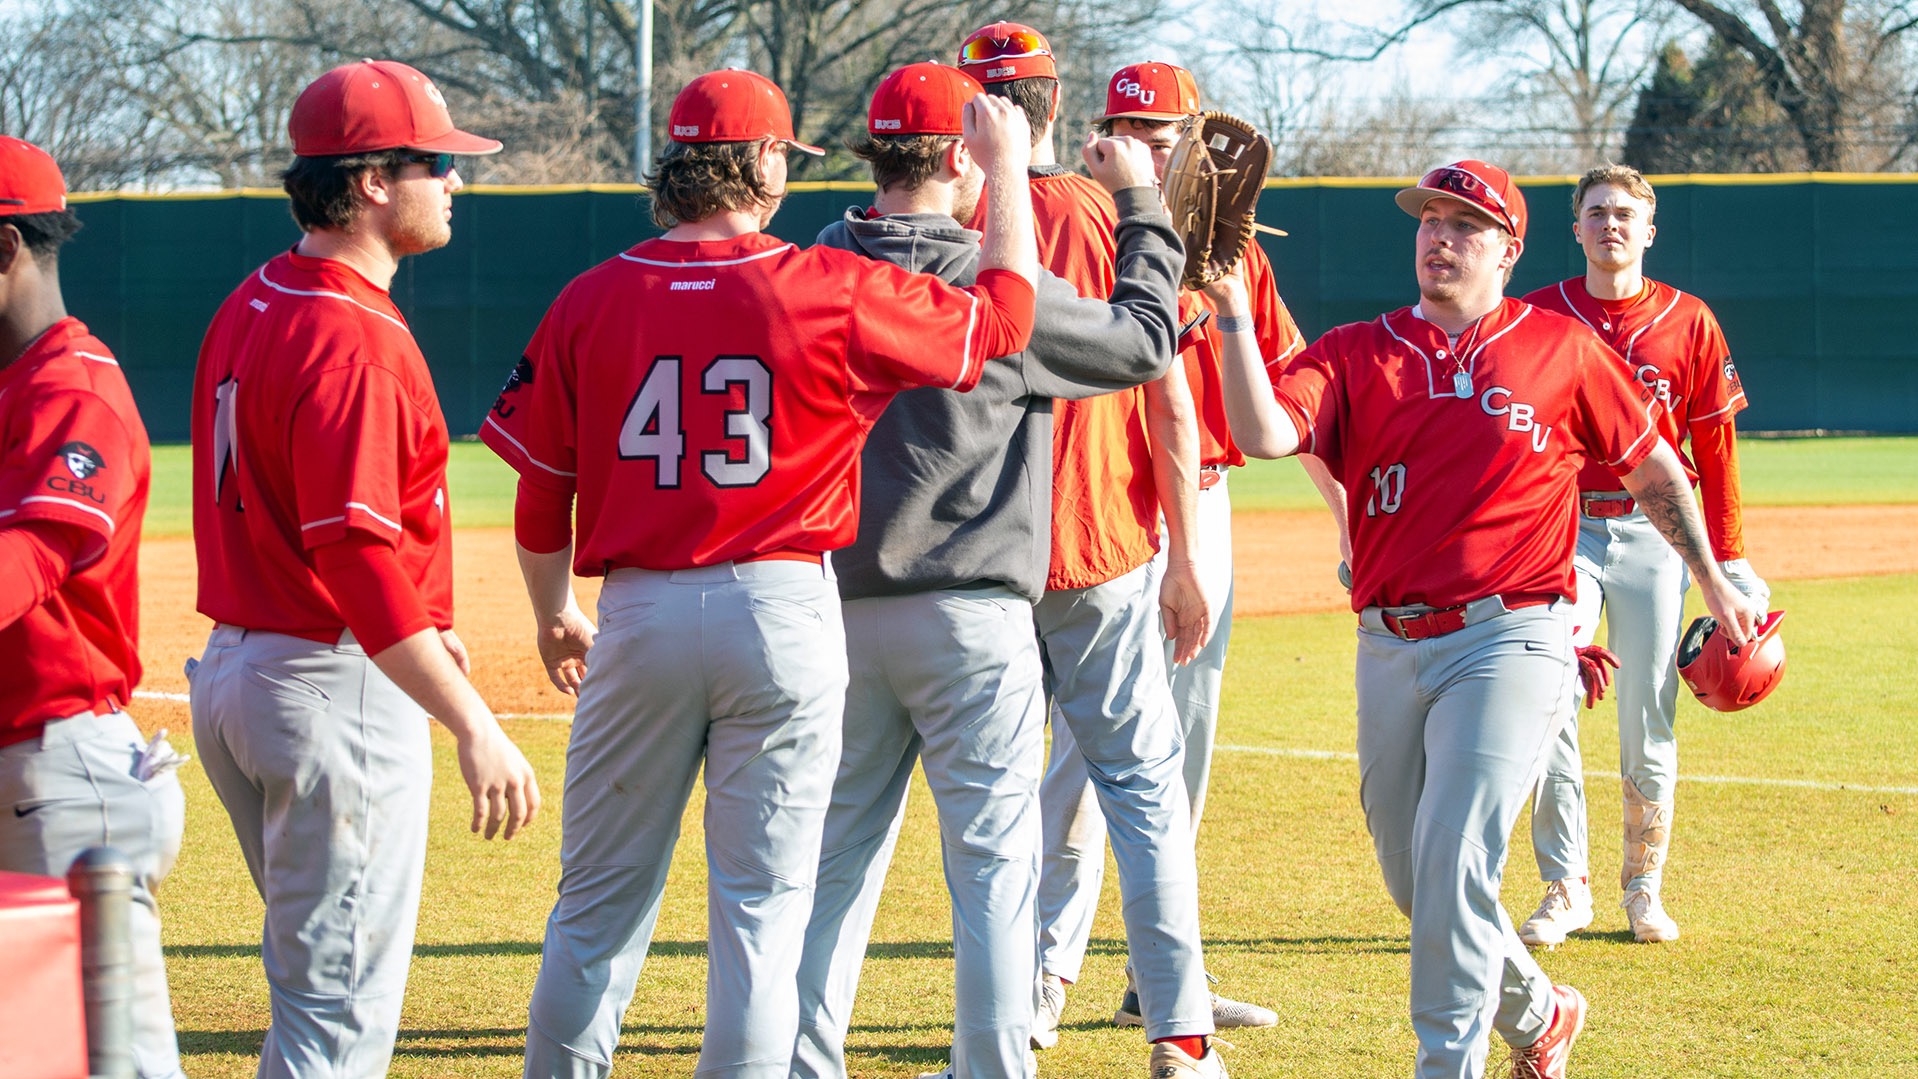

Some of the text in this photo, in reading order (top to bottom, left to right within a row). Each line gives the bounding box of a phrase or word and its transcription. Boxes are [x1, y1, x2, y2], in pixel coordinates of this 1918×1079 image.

[1116, 78, 1156, 106] CBU
[670, 278, 716, 290] marucci
[1635, 363, 1684, 413] CBU
[618, 354, 774, 490] 43
[1481, 386, 1552, 453] CBU
[46, 476, 106, 504] CBU
[1367, 462, 1407, 517] 10
